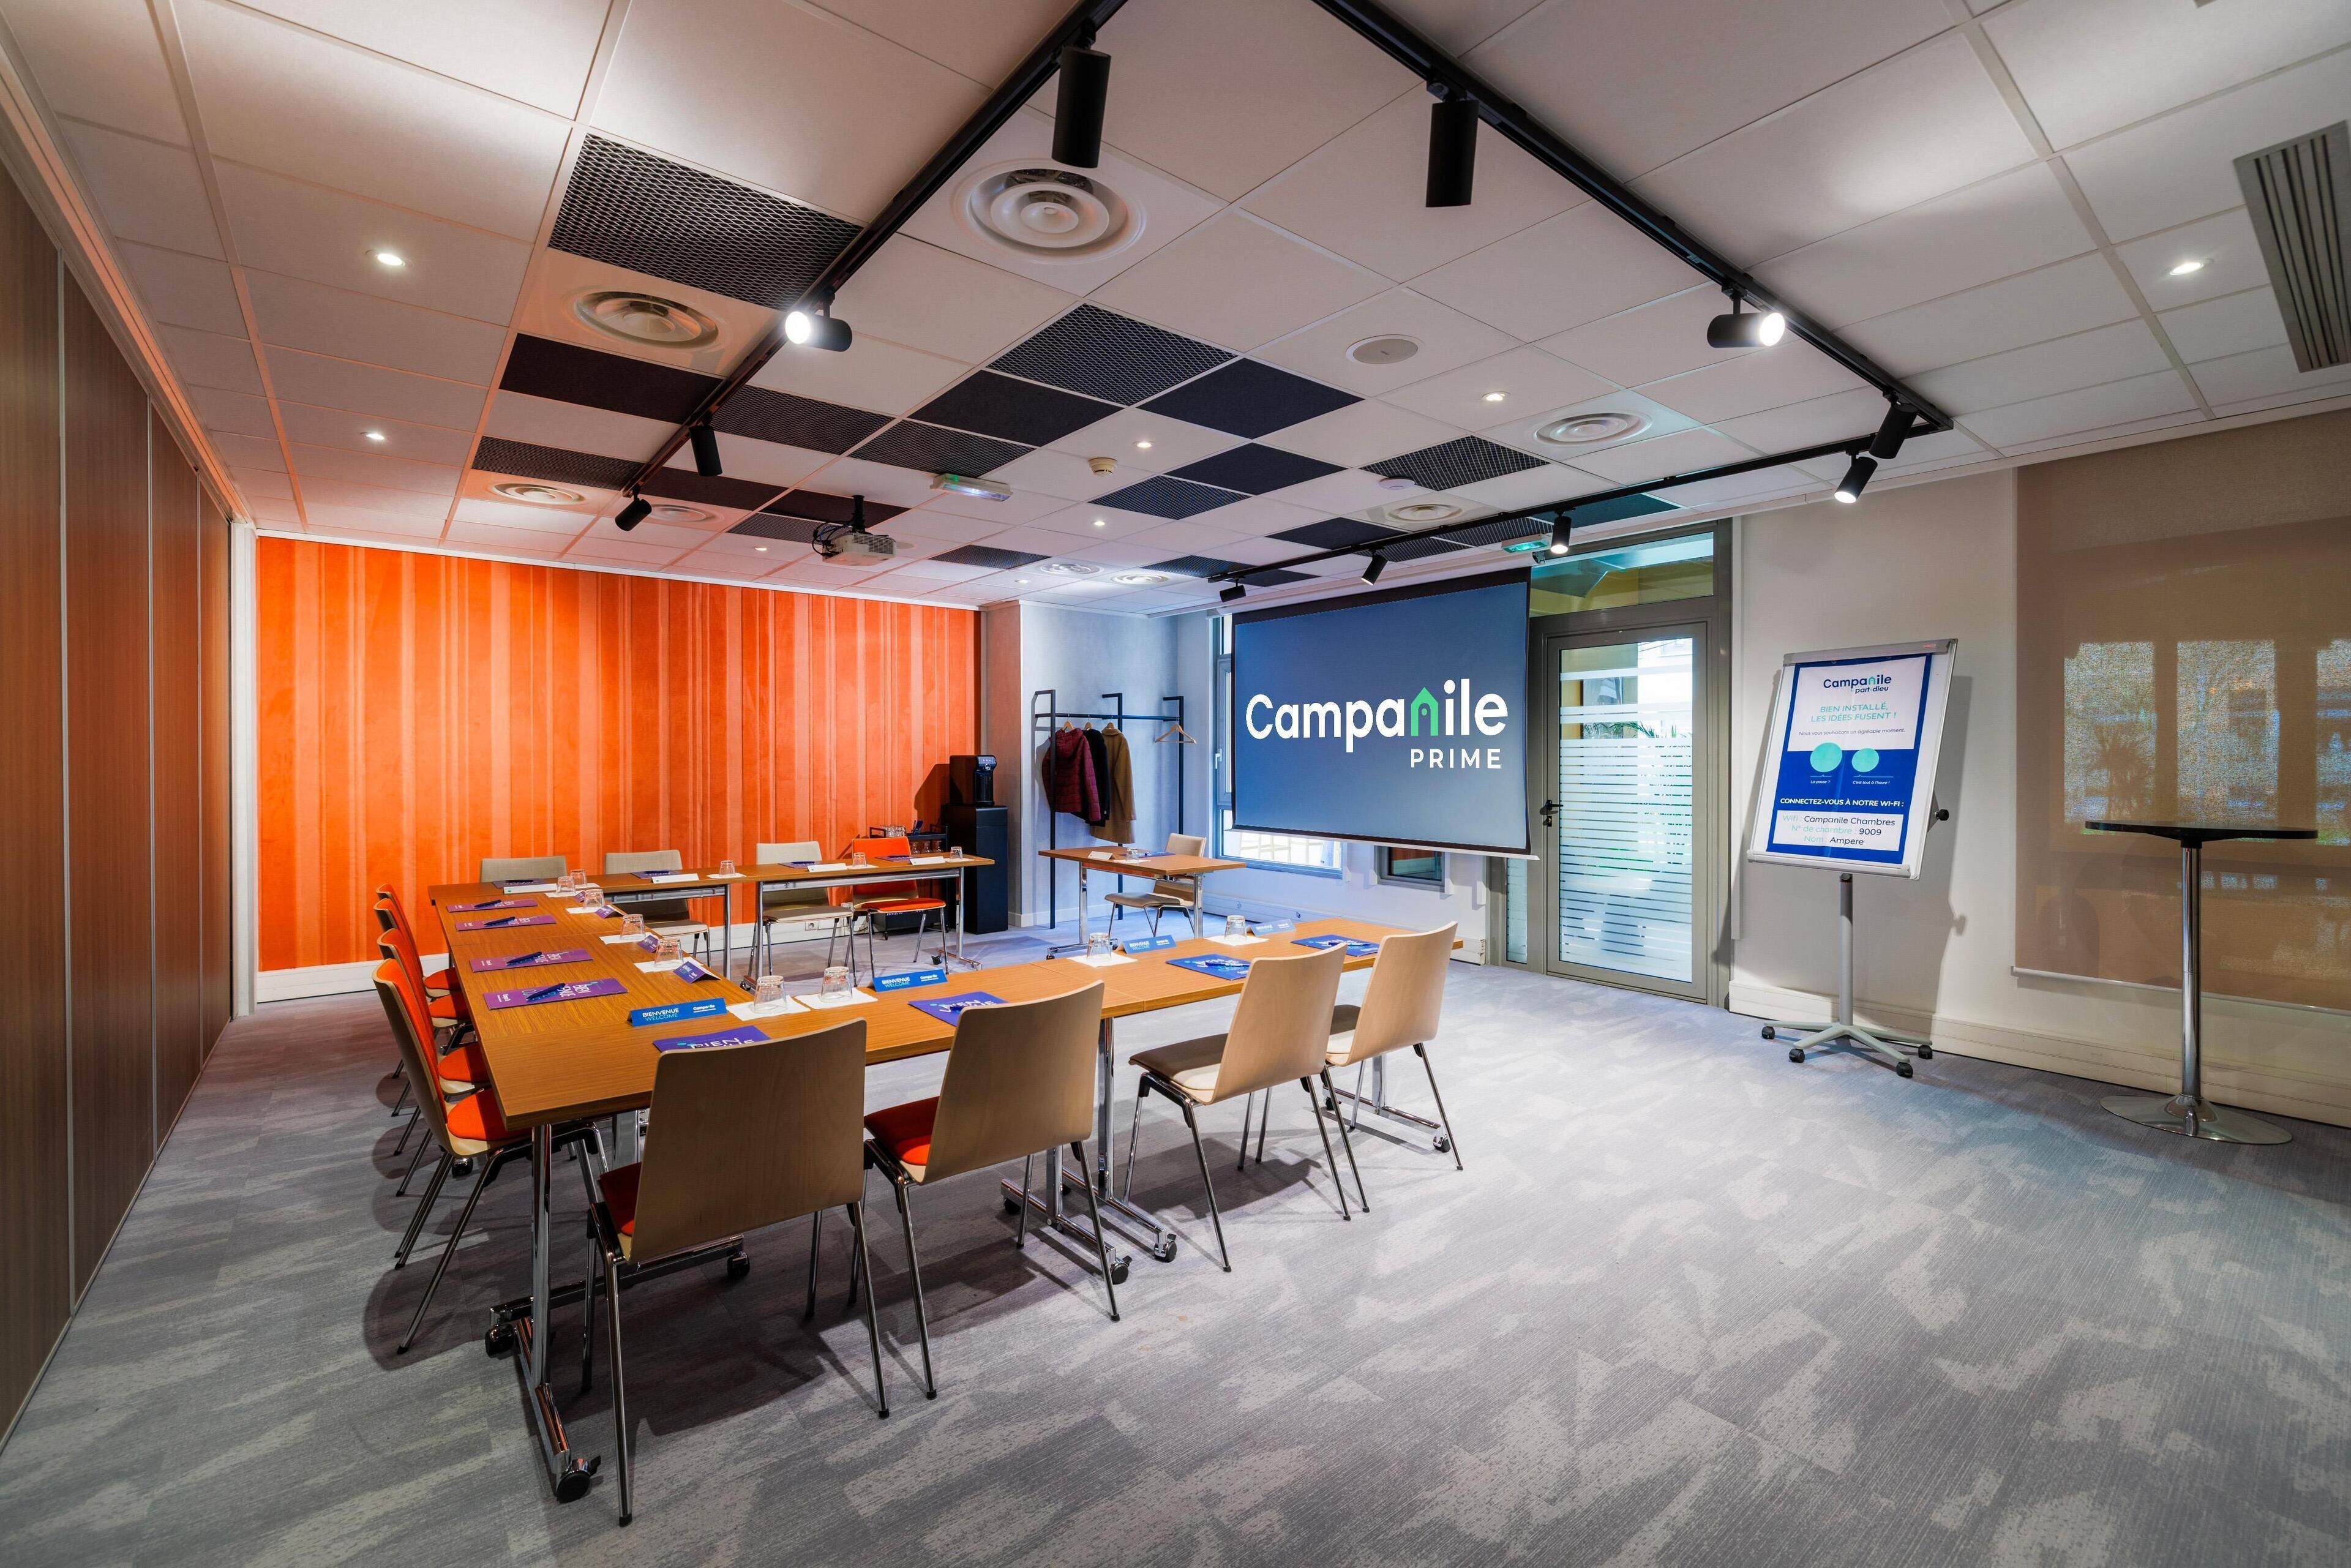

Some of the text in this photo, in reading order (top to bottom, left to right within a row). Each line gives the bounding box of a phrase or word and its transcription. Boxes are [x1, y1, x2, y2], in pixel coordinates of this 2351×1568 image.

[1823, 674, 1892, 688] Campanile
[1842, 701, 1888, 711] INSTALLÉ,
[1245, 678, 1508, 752] Campanile
[1411, 748, 1501, 769] PRIME
[1804, 816, 1848, 824] Campanile
[1851, 817, 1895, 826] Chambres
[1829, 837, 1864, 846] Ampere
[642, 1008, 679, 1018] BIENVENUE
[645, 1013, 678, 1021] WELCOME
